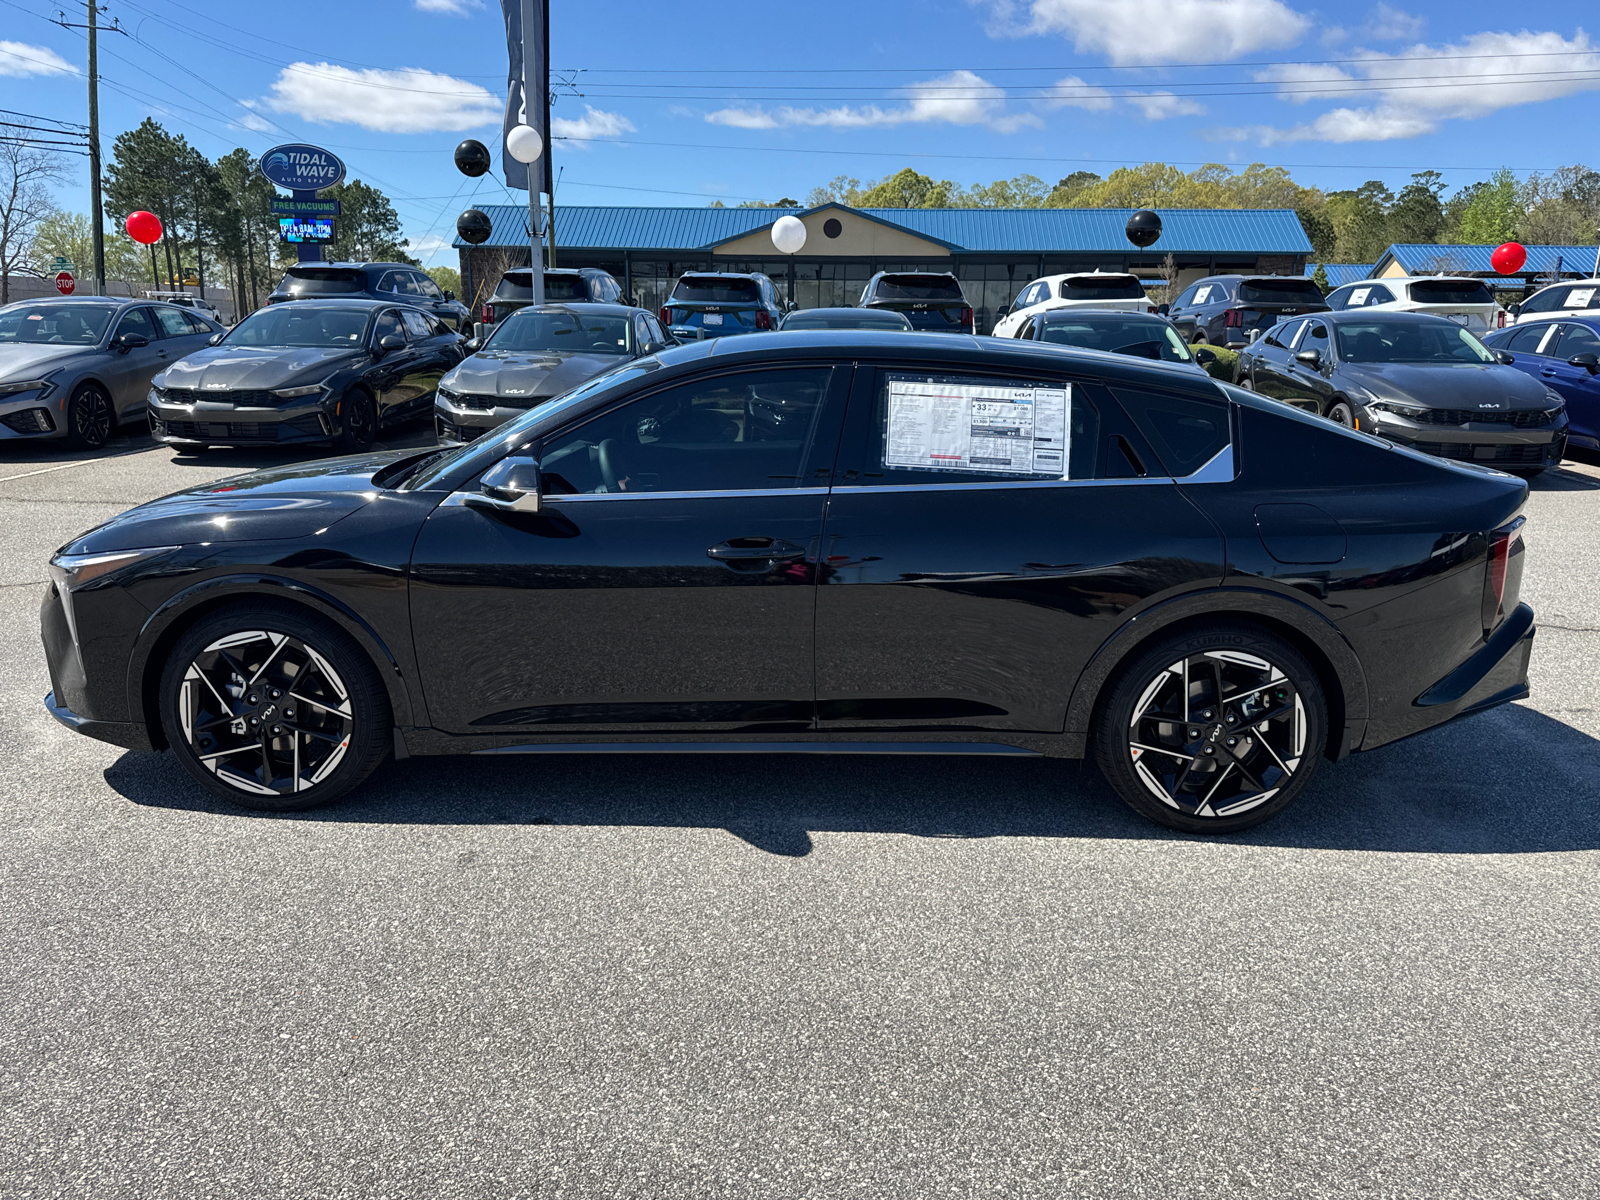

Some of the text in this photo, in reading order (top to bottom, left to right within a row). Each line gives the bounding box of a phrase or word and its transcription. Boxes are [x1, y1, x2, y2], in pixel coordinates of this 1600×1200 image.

[289, 152, 327, 165] TIDAL
[296, 165, 335, 178] WAVE
[297, 202, 335, 210] VACUUMS
[57, 280, 74, 288] STOP
[1185, 635, 1243, 648] KUMHO
